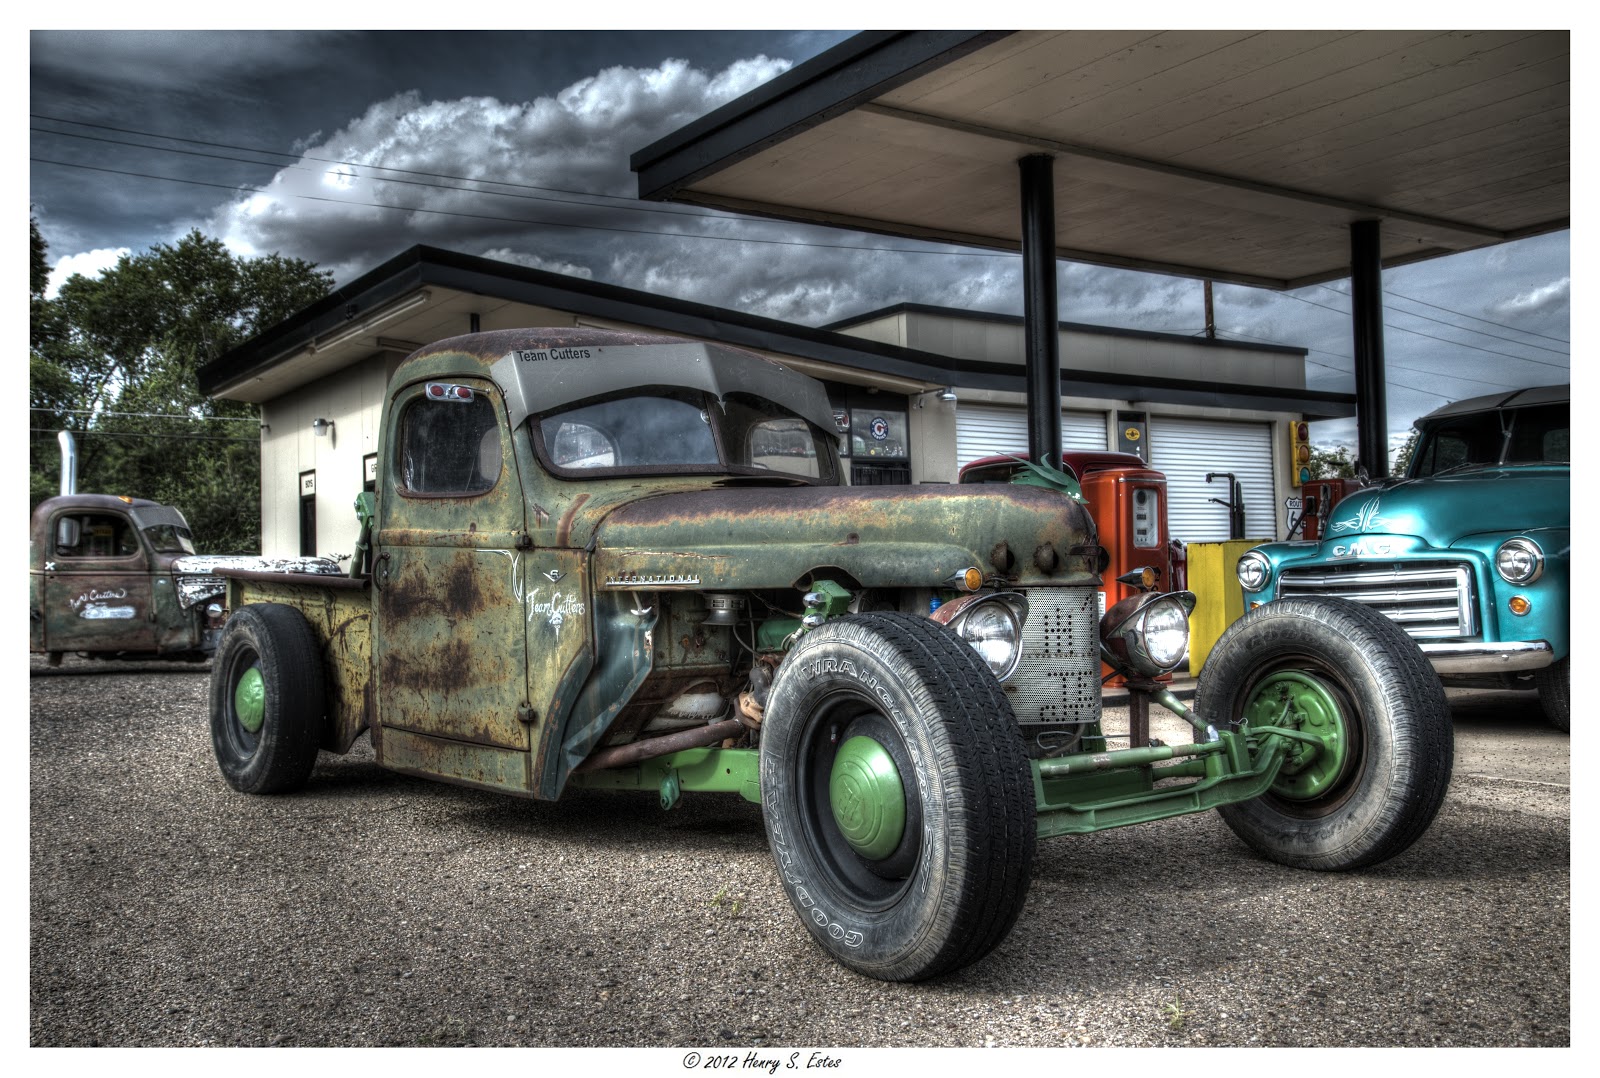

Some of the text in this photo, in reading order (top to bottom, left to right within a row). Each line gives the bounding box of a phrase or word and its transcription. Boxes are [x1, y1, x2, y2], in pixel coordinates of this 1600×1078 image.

[516, 348, 591, 362] Team Cutters
[1289, 500, 1303, 508] ROUT
[1332, 541, 1392, 557] GMC
[606, 574, 700, 584] INTERNATIONAL
[801, 658, 932, 801] WRANGLER
[764, 757, 864, 948] GOODYEAR
